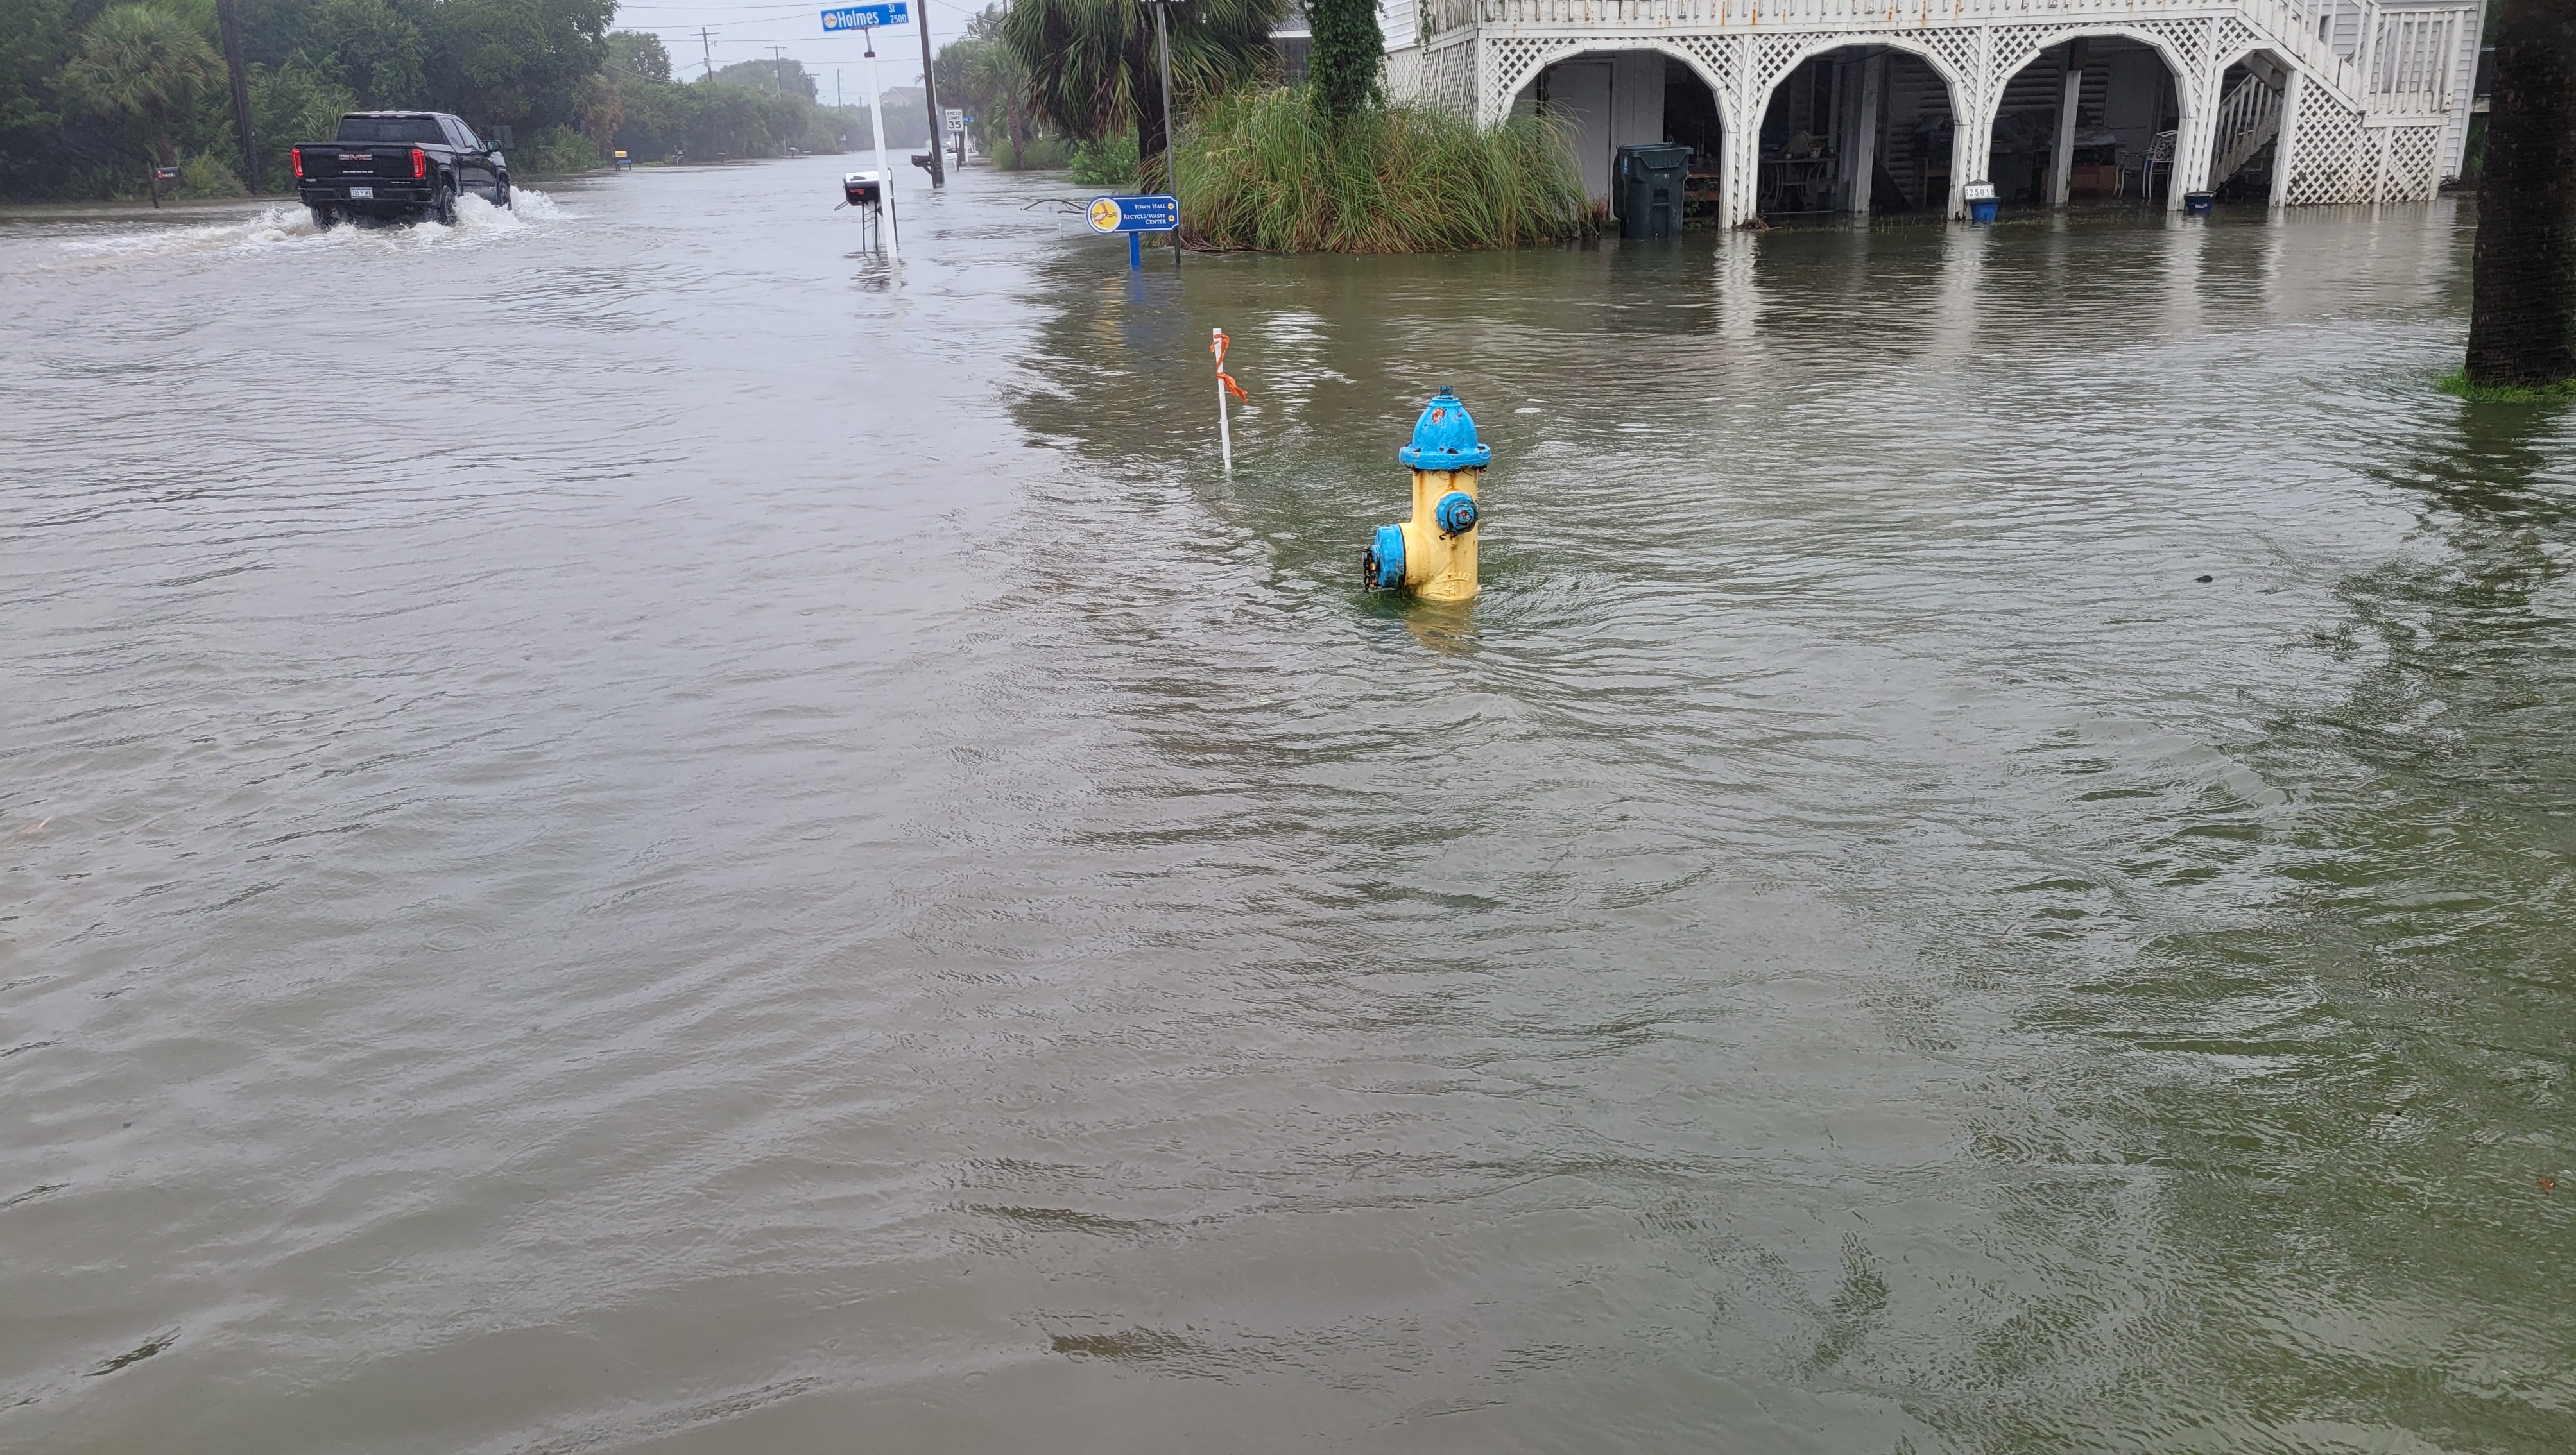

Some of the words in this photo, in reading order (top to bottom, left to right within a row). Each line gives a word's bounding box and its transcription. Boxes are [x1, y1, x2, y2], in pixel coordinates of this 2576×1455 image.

[837, 10, 879, 28] Holmes
[888, 4, 895, 13] St
[889, 13, 907, 24] 2500
[948, 121, 961, 129] 35
[1969, 188, 1989, 196] 2501
